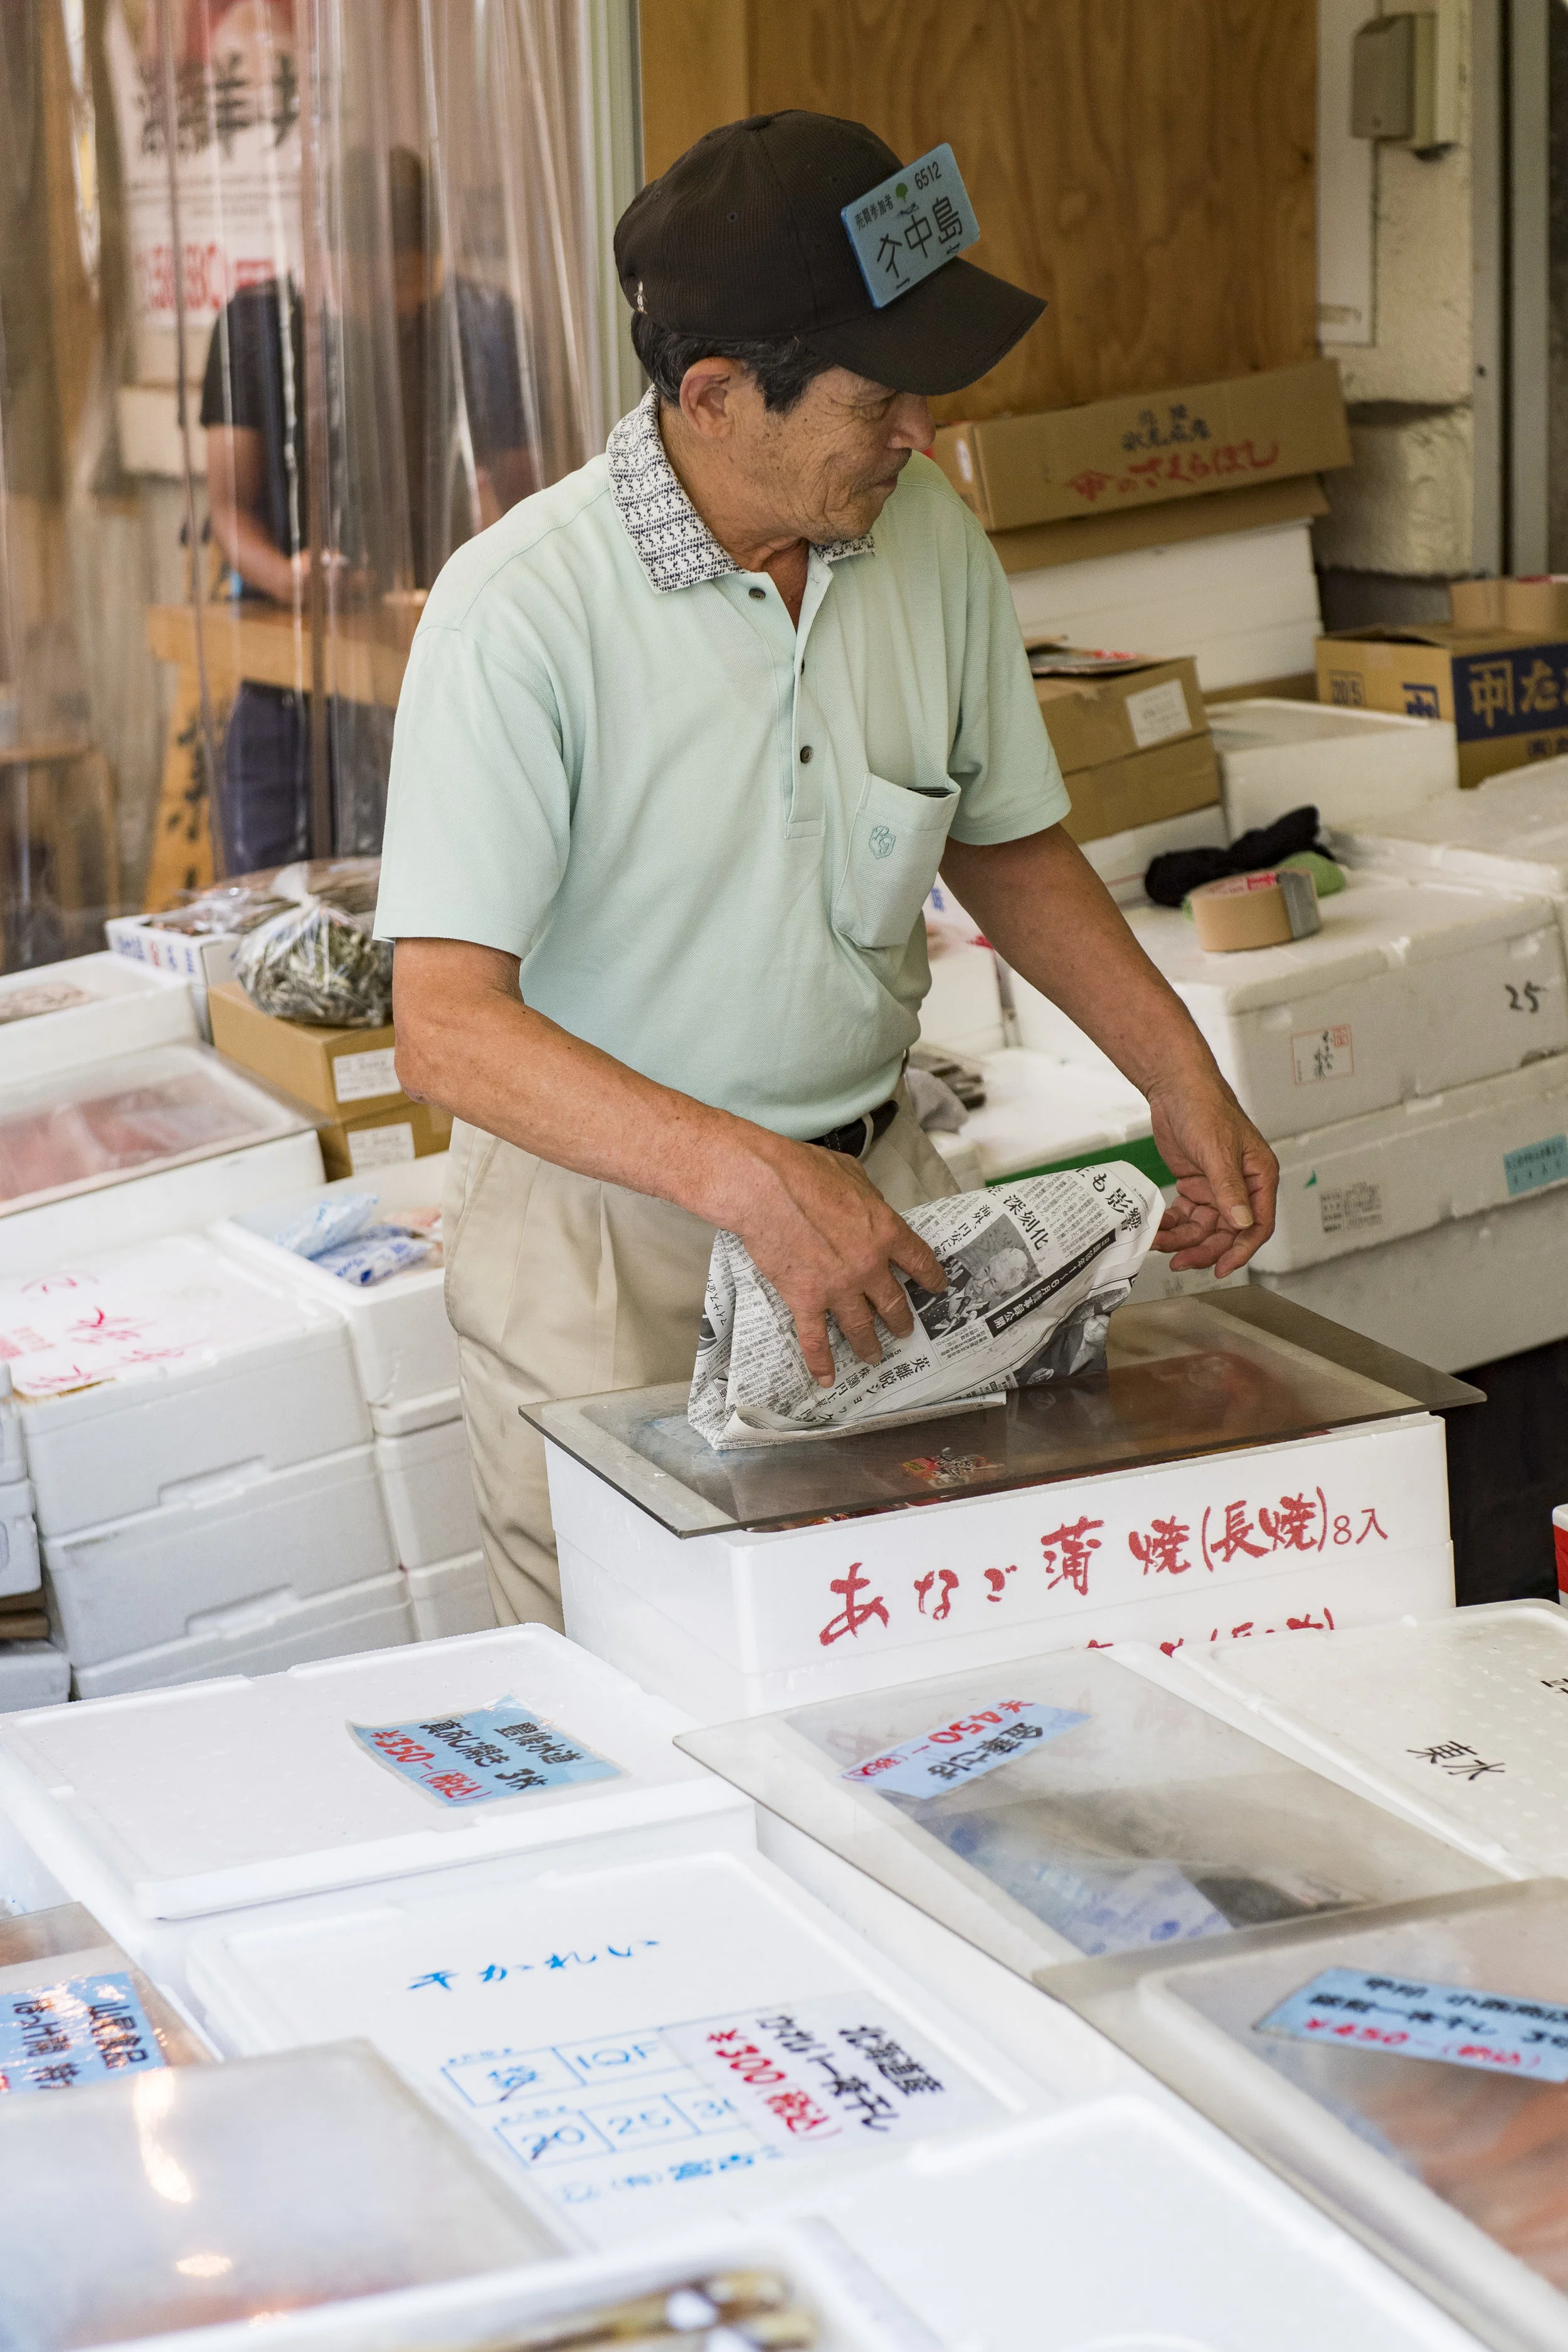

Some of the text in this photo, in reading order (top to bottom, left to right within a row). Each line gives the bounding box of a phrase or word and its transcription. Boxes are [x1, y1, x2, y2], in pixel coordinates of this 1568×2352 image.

[914, 161, 942, 190] 6512
[854, 194, 894, 231] 売買参加者
[1505, 980, 1548, 1014] 25
[818, 1354, 931, 1420] 英離脱ショック
[420, 1720, 549, 1791] 真あじ開き 3枚
[494, 1721, 585, 1764] 豊後水道
[928, 1722, 1044, 1780] 金華さば
